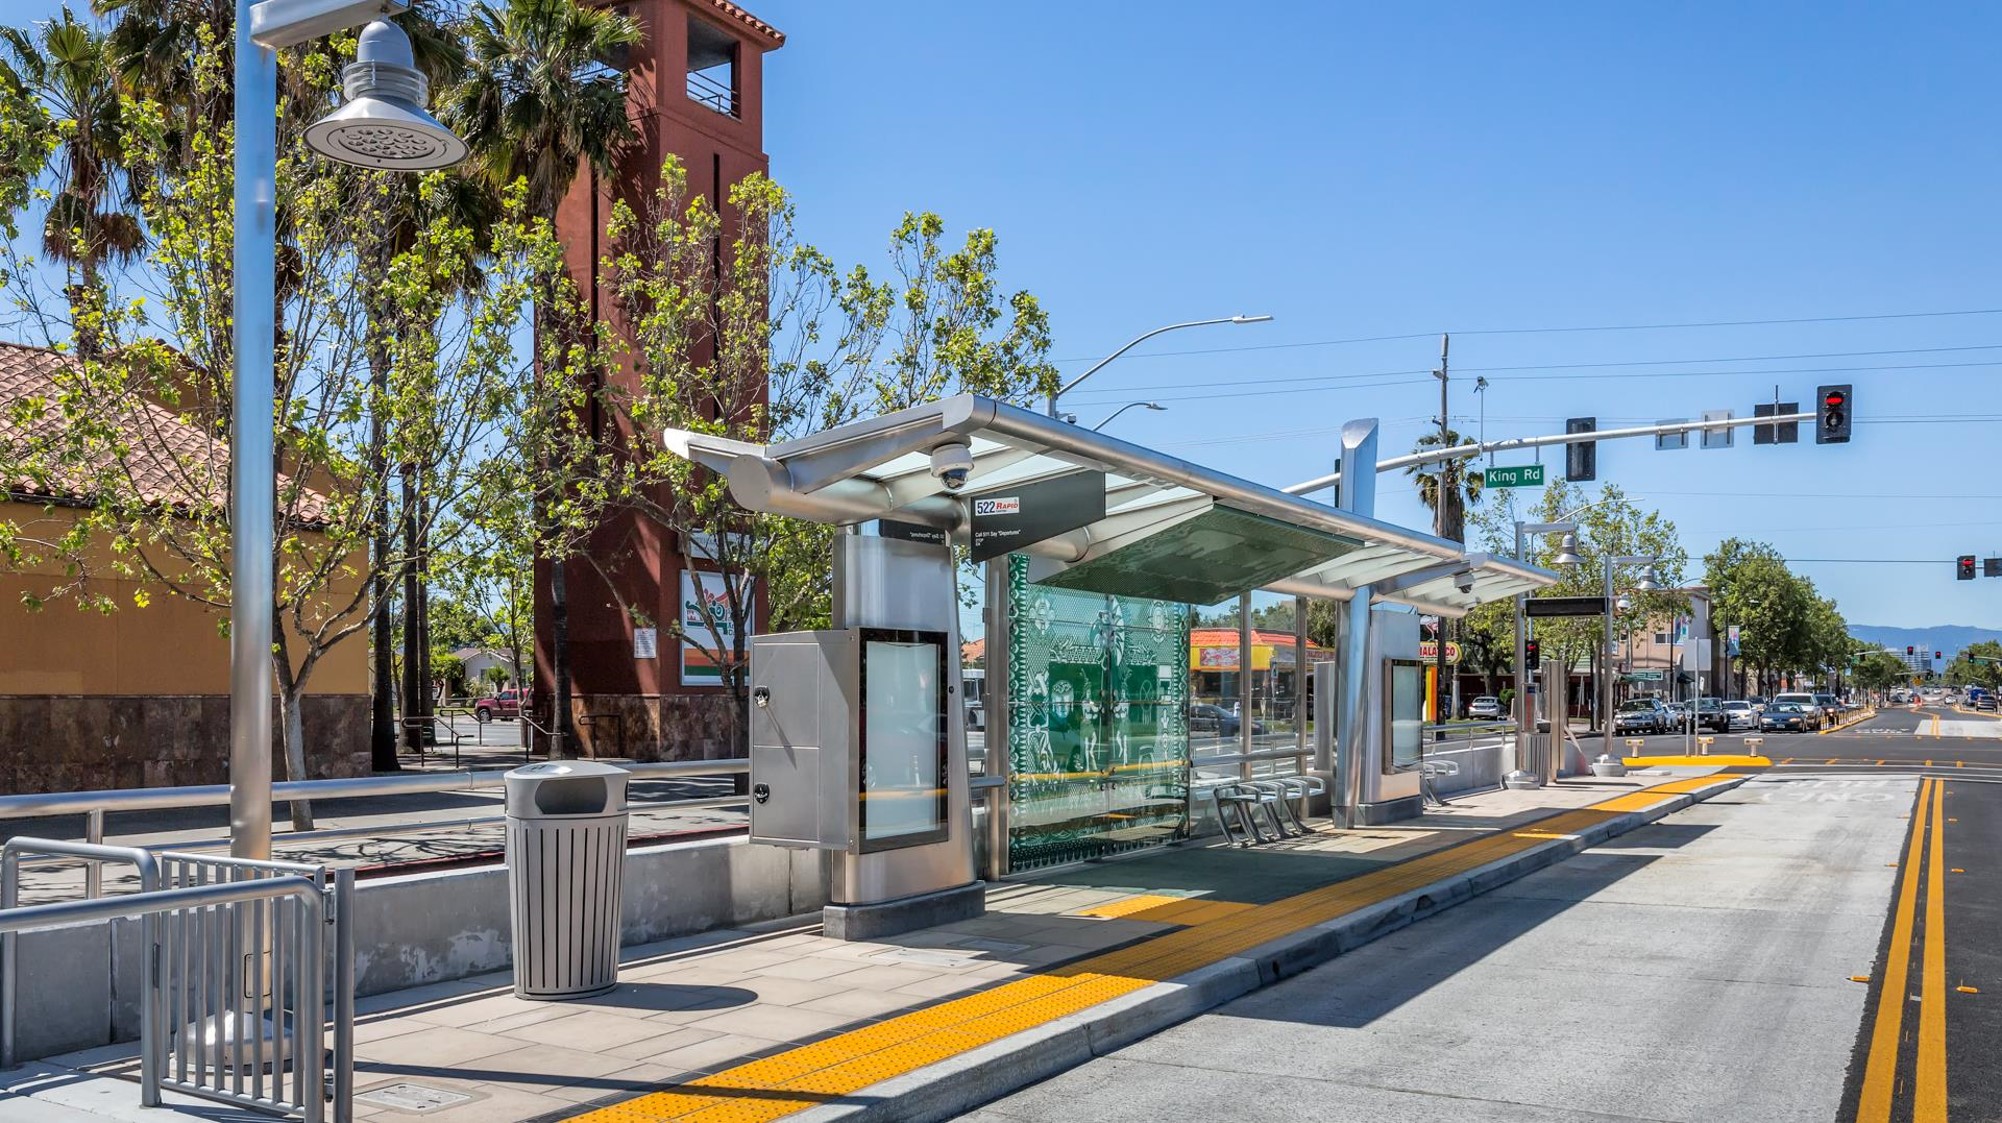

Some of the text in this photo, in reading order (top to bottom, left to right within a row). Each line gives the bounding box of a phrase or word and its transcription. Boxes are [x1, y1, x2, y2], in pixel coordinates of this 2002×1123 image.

[1489, 468, 1540, 484] King Rd
[977, 501, 995, 514] 522
